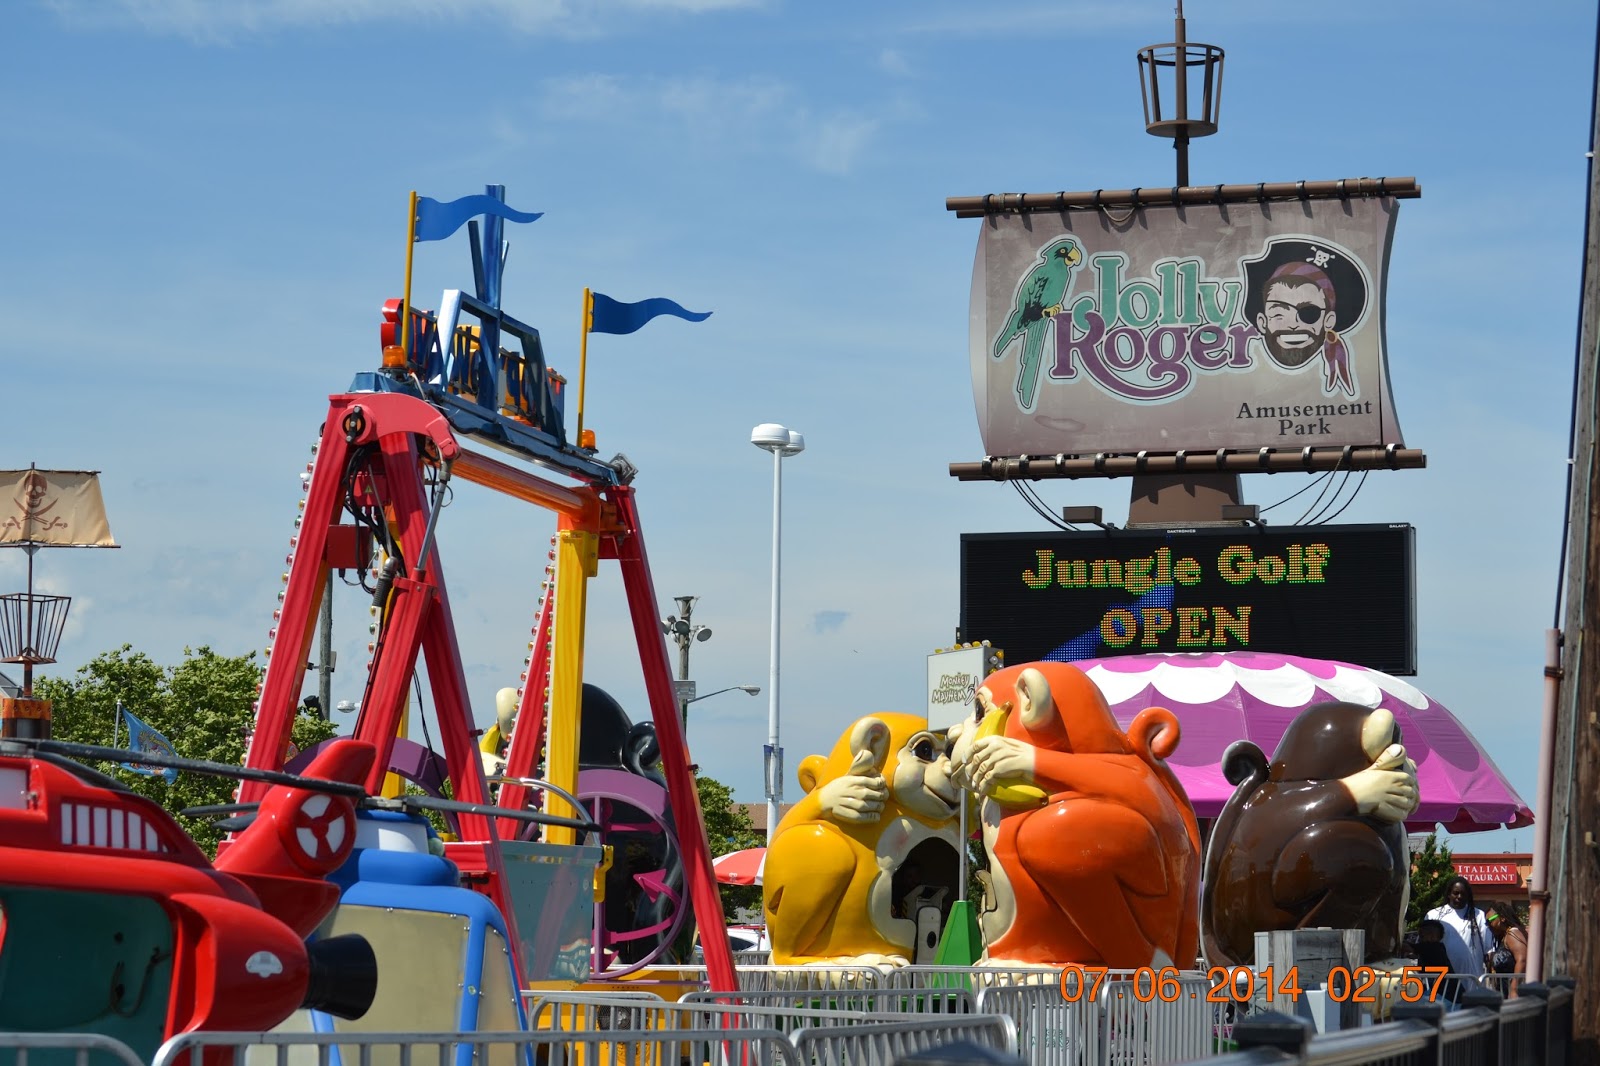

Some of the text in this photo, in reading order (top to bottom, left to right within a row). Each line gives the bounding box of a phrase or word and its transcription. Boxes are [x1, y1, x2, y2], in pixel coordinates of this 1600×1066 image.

[1073, 256, 1241, 341] Jolly
[1049, 309, 1258, 400] Roger
[1236, 401, 1373, 419] Amusement
[1278, 417, 1332, 436] Park
[1022, 543, 1331, 595] Jungle Golf
[1100, 606, 1252, 648] OPEN
[1458, 865, 1508, 873] ITALIAN
